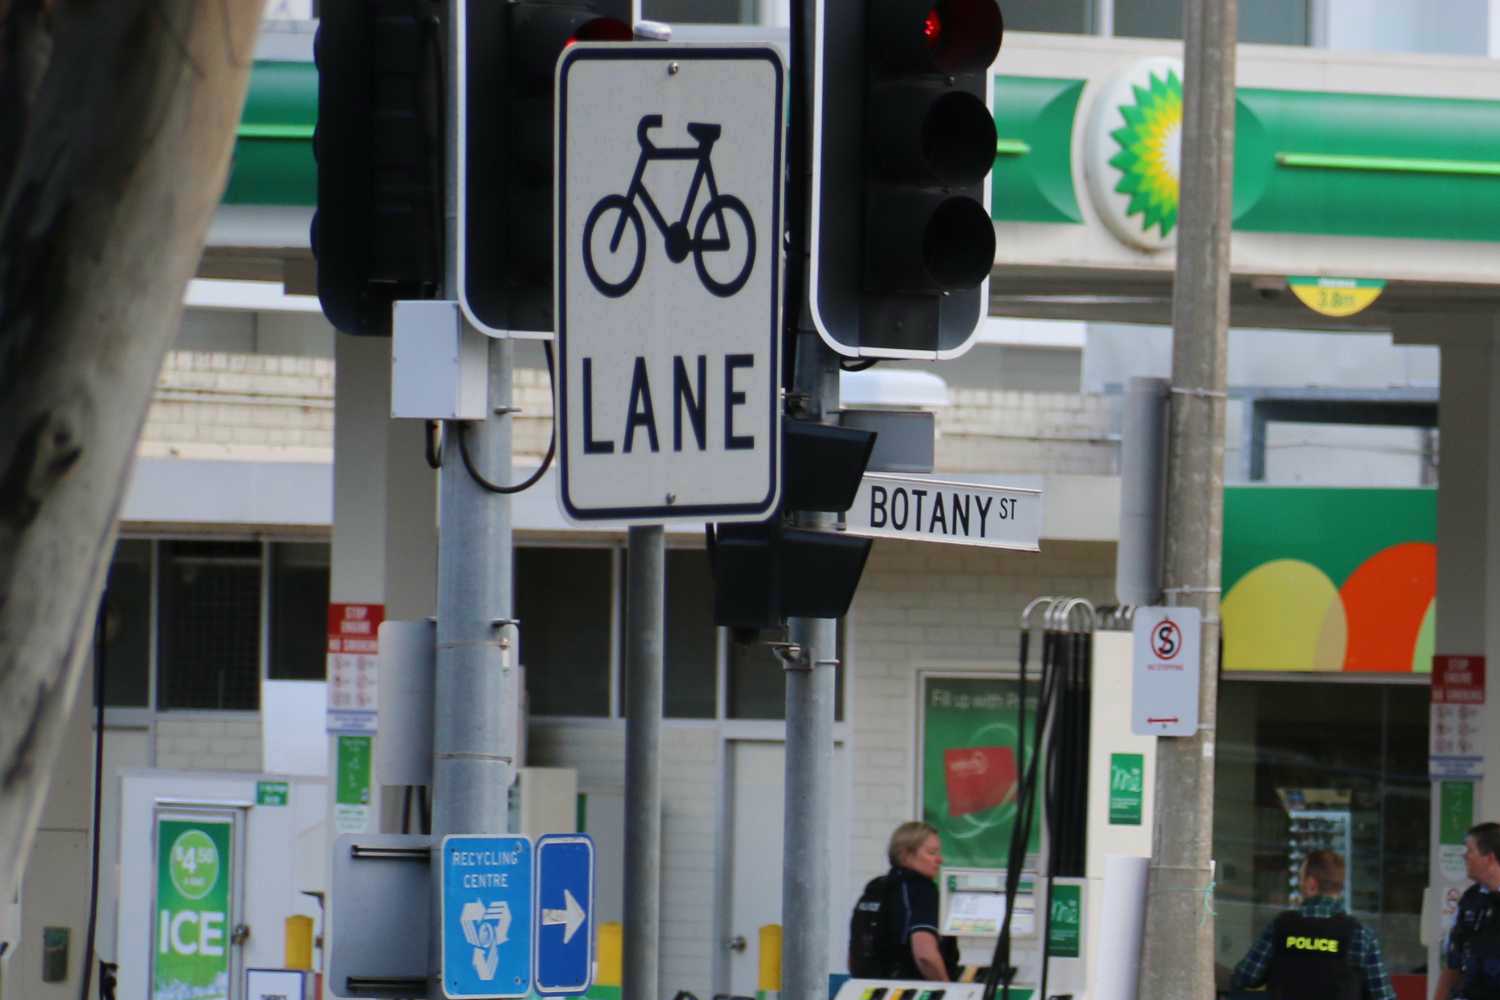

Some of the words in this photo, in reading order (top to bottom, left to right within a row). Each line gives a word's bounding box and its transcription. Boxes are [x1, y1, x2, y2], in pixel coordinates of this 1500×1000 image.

[582, 354, 756, 455] LANE
[870, 485, 993, 538] BOTANY
[999, 497, 1017, 520] ST
[452, 851, 518, 866] RECYCLING
[463, 873, 509, 888] CENTRE
[161, 909, 225, 955] ICE
[1286, 936, 1339, 952] POLICE
